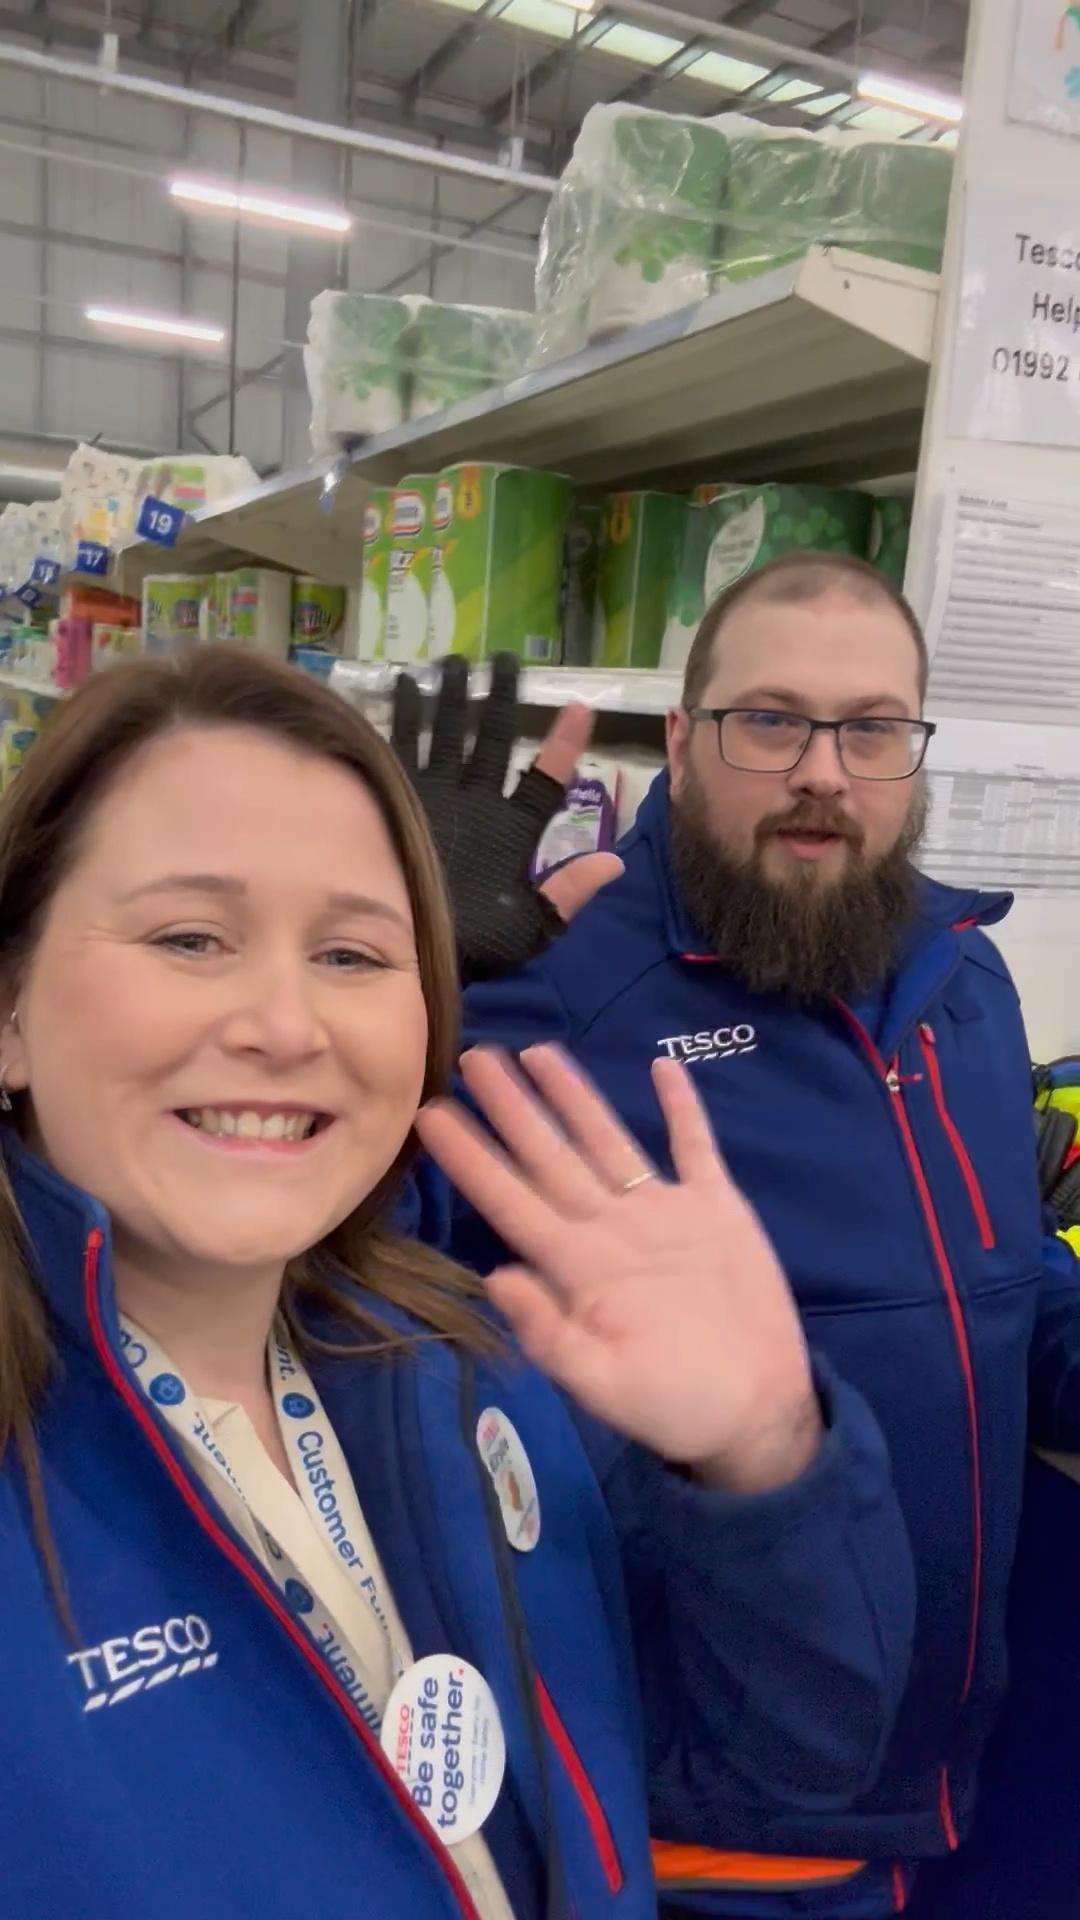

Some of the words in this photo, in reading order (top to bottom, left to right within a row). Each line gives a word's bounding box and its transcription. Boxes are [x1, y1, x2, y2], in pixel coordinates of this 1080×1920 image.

[991, 346, 1069, 382] 01992
[148, 510, 173, 535] 19
[656, 1023, 756, 1058] TESCO
[296, 1430, 364, 1570] Customer
[66, 1613, 212, 1691] TESCO
[417, 1676, 439, 1750] safe
[437, 1667, 465, 1830] together.
[411, 1760, 434, 1808] Be
